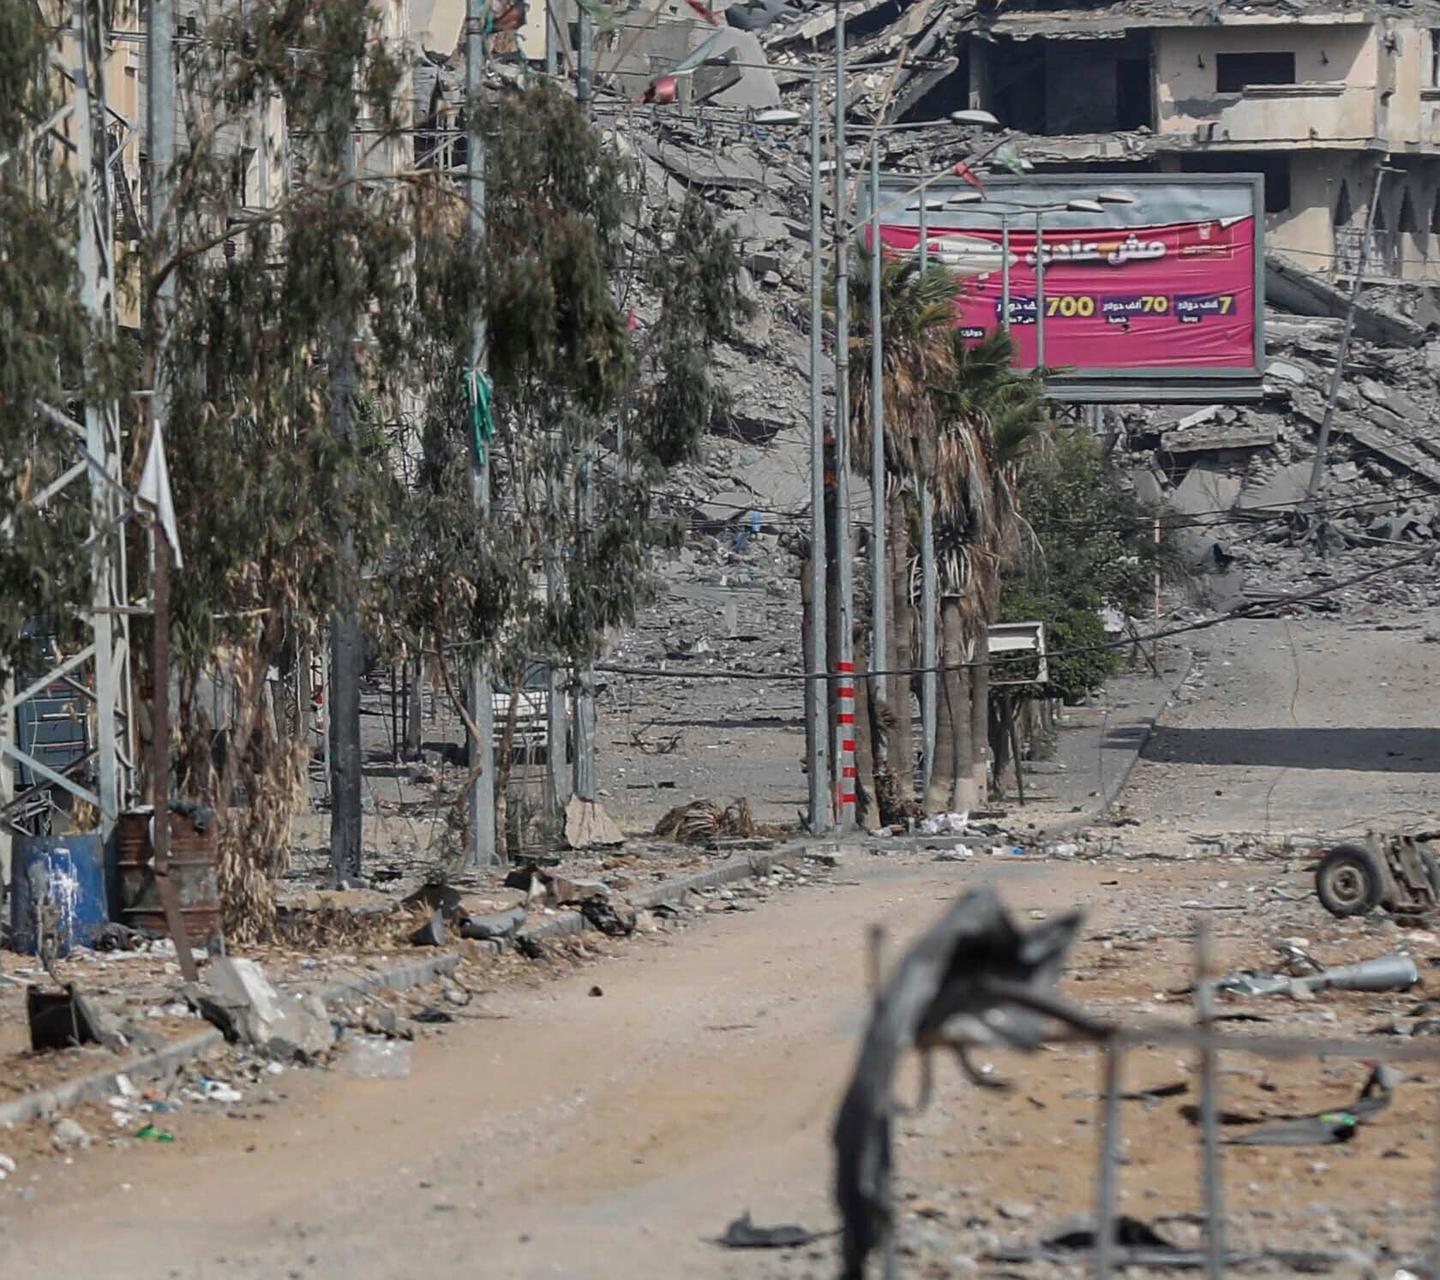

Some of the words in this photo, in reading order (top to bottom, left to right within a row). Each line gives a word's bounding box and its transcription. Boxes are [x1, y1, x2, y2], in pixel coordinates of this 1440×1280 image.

[1107, 233, 1167, 266] مش
[1045, 296, 1095, 317] 700
[1141, 296, 1168, 313] 70
[1218, 295, 1233, 315] 7
